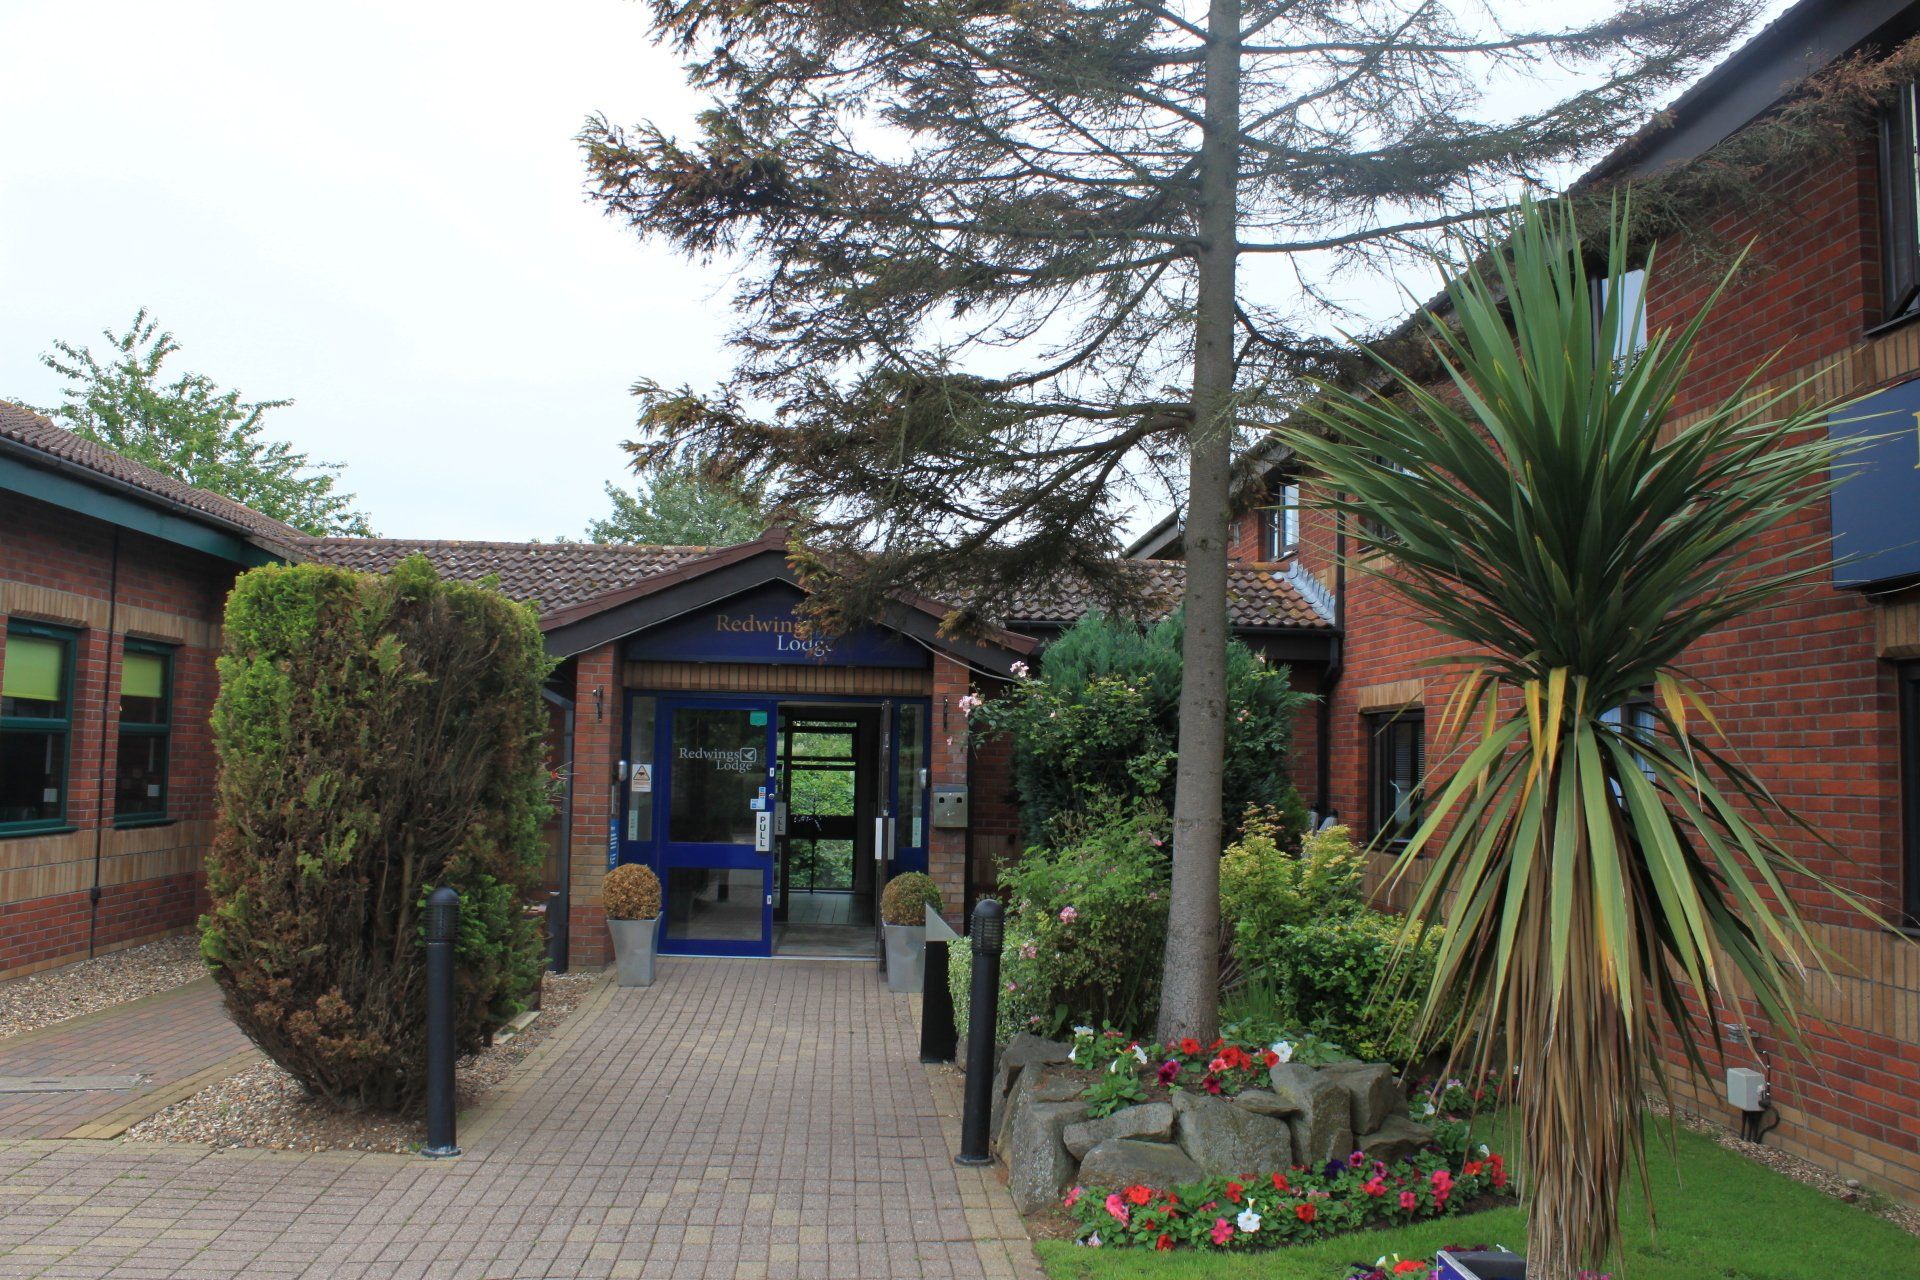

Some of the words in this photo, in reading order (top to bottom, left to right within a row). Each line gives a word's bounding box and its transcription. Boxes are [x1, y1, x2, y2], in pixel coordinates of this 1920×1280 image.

[716, 614, 811, 640] Redwing
[680, 747, 740, 762] Redwings
[716, 760, 753, 773] Lodge
